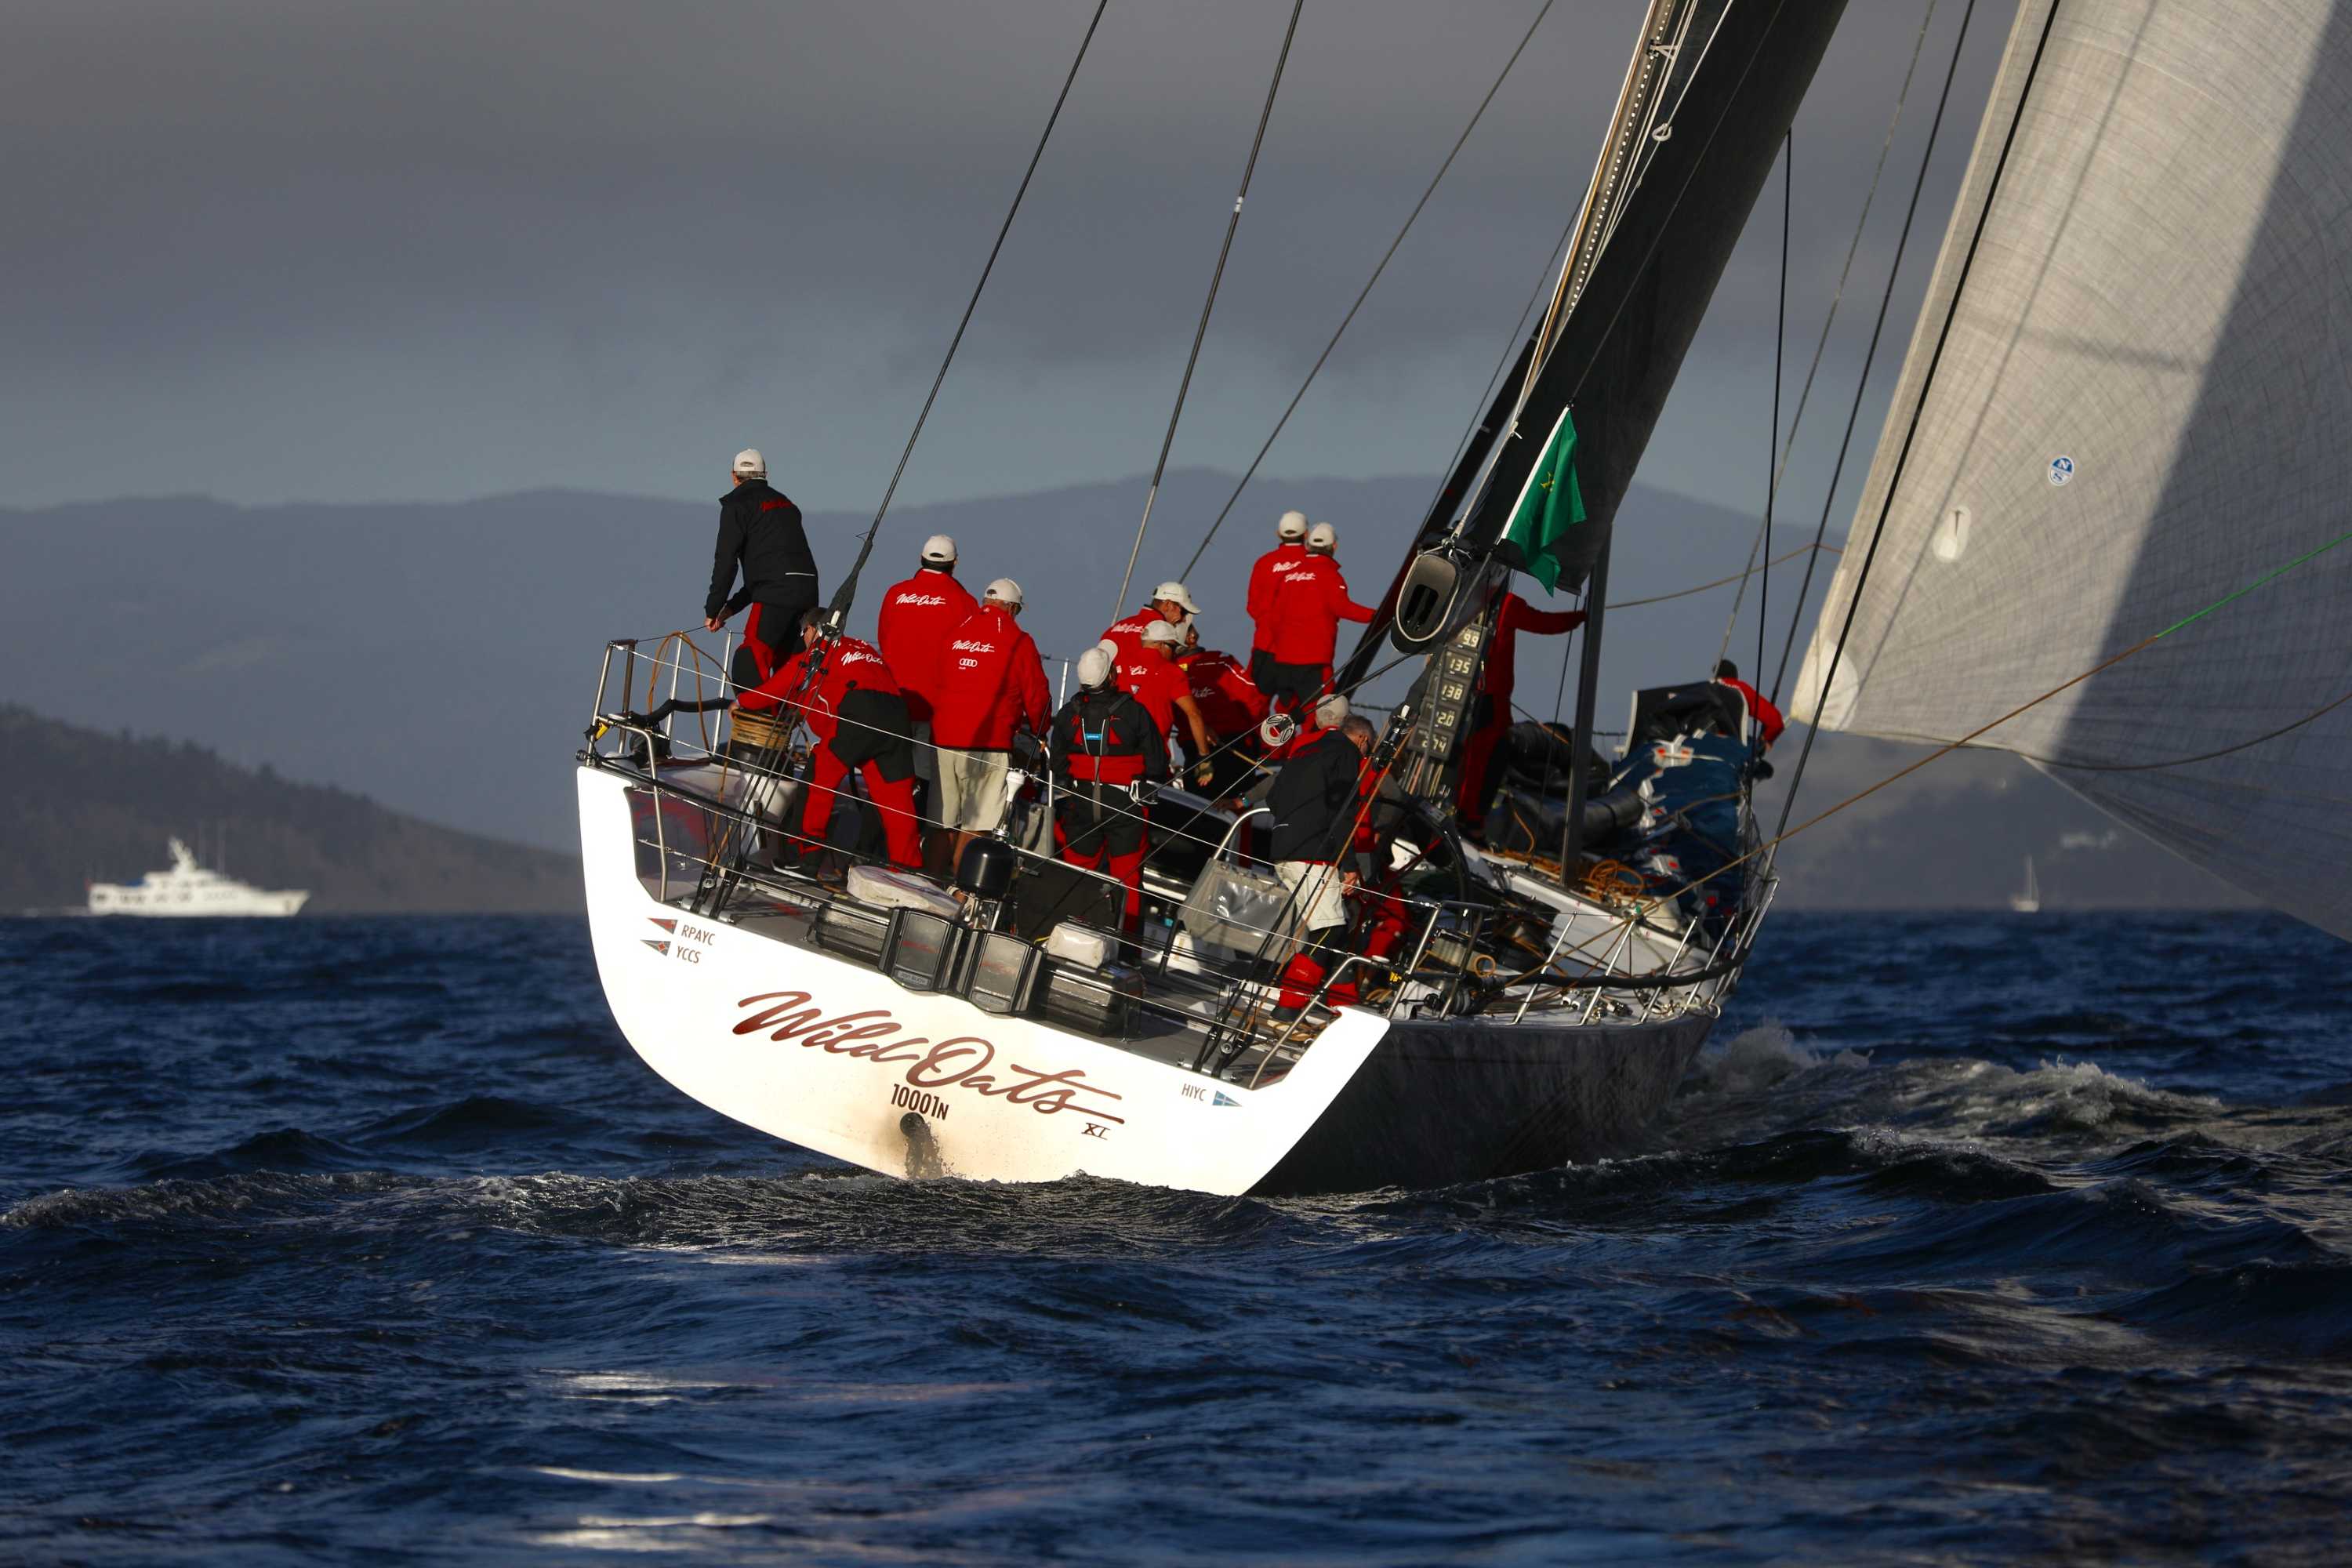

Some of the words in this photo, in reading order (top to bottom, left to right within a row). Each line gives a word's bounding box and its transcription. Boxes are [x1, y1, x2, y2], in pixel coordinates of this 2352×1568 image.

[681, 924, 716, 946] RPAYC
[677, 946, 701, 964] YCCS
[732, 991, 929, 1062] Wild
[906, 1036, 1124, 1124] Oats
[1181, 1083, 1206, 1102] HIYC
[1081, 1122, 1111, 1140] XI
